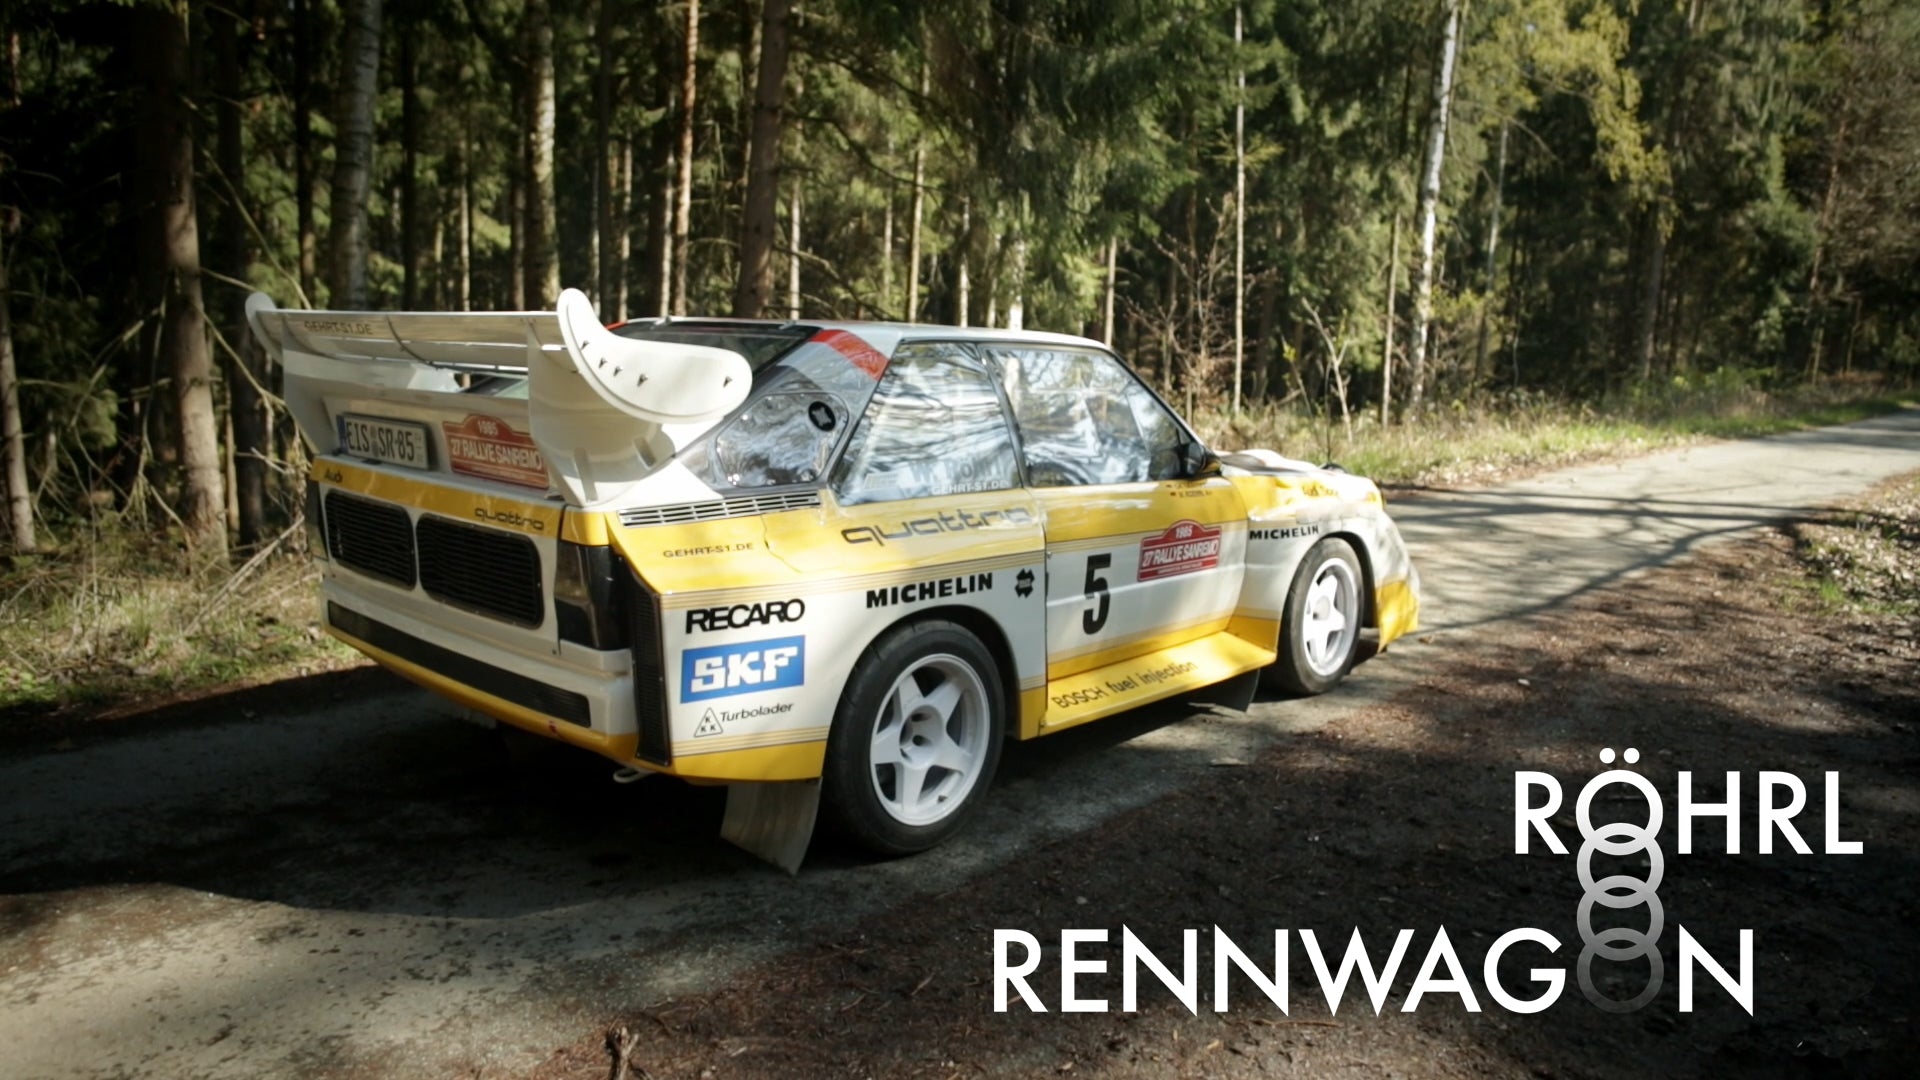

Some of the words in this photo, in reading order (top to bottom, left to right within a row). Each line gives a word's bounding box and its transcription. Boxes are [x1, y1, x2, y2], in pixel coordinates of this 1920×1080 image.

[346, 421, 370, 452] EIS
[462, 440, 495, 462] RALLYE
[495, 446, 542, 470] SANREMO
[474, 508, 544, 530] quattro
[841, 508, 1033, 547] quattro
[1175, 525, 1194, 539] 1985
[1249, 525, 1319, 540] MICHELIN
[663, 542, 753, 558] GEHRT-S1.DE
[1153, 545, 1182, 565] RALLYE
[1182, 539, 1219, 560] SANREMO
[866, 572, 992, 609] MICHELIN
[1083, 553, 1111, 635] 5
[685, 599, 806, 634] RECARO
[690, 646, 798, 693] SKF
[1051, 686, 1109, 709] BOSCH
[1105, 676, 1140, 694] fuel
[1136, 661, 1198, 684] injection
[720, 703, 794, 722] Turbolader
